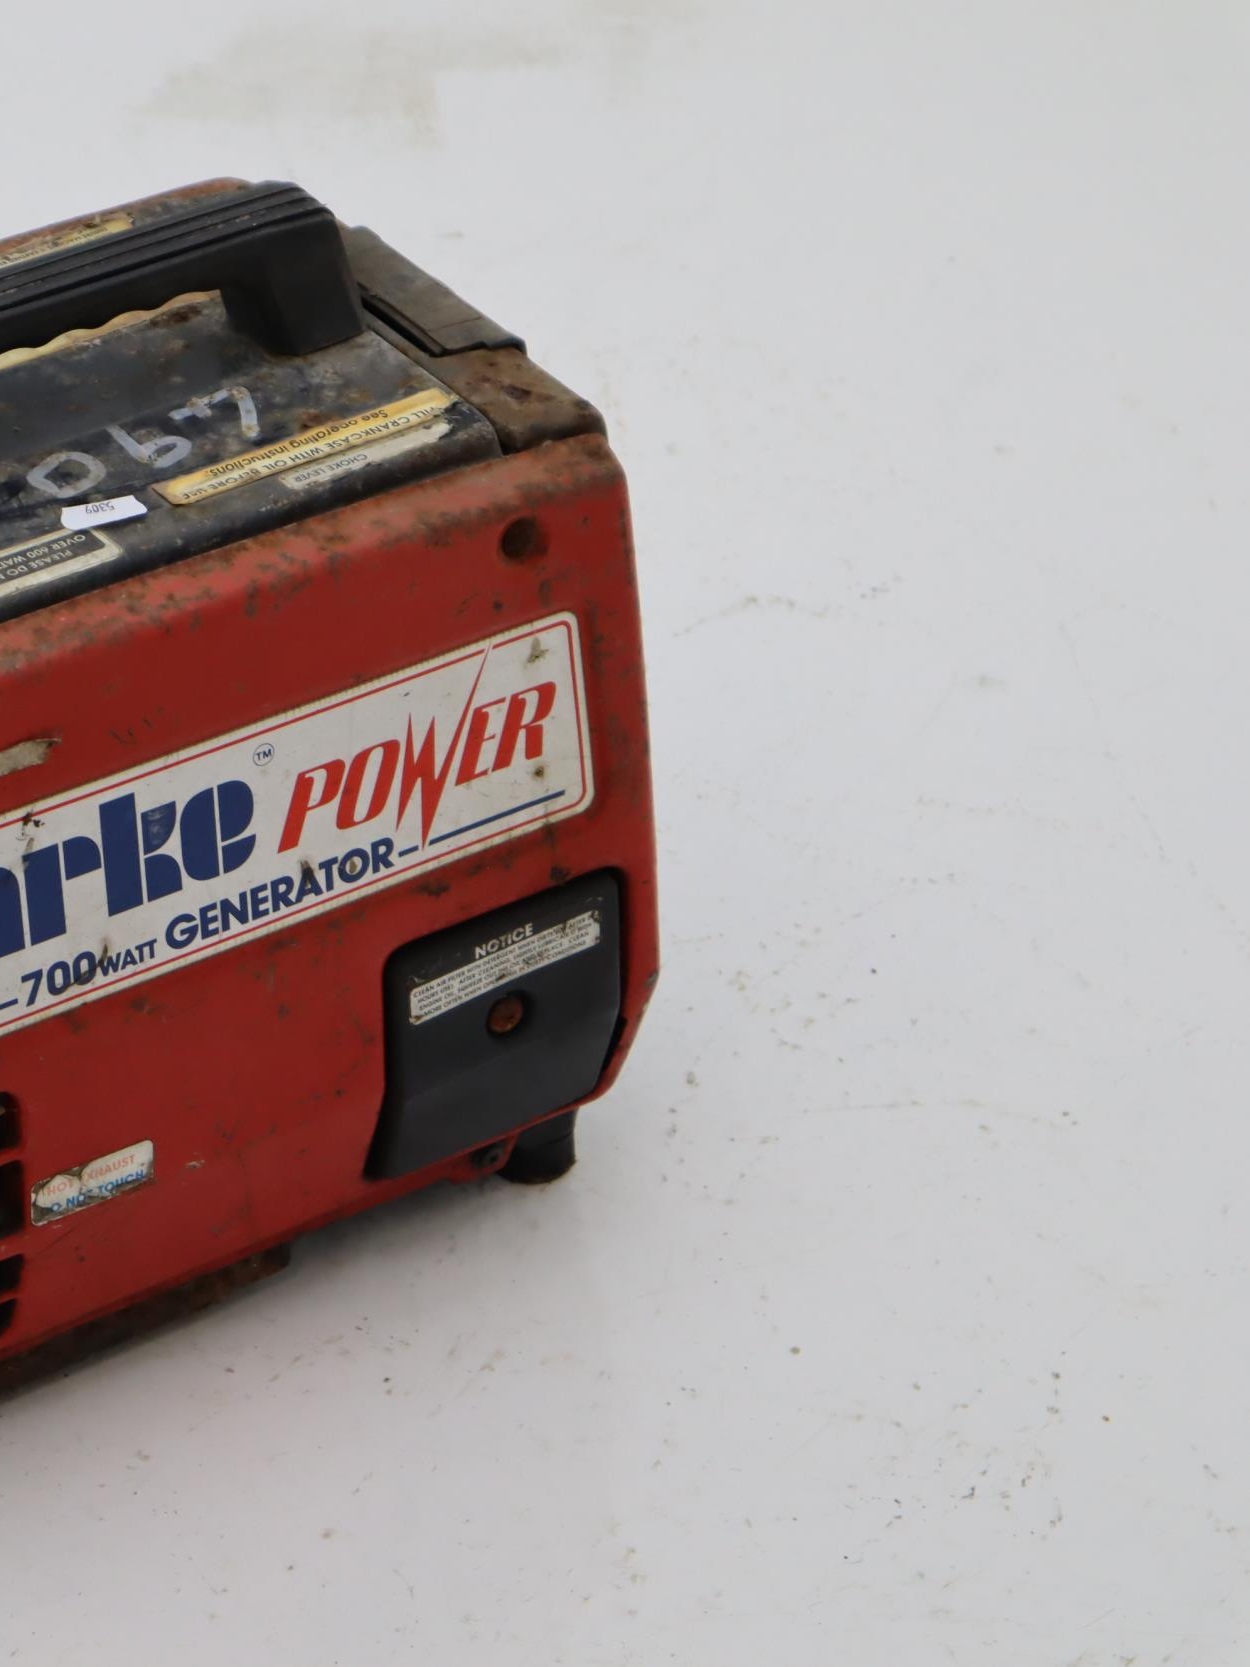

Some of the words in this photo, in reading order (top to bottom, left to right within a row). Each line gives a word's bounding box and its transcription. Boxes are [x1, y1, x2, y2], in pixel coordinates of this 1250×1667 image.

[359, 408, 389, 424] See
[323, 414, 411, 450] CRANKCASE
[287, 445, 325, 463] WITH
[325, 450, 369, 474] CHOKE
[260, 458, 289, 472] OIL
[292, 465, 326, 485] LEVER
[85, 501, 115, 514] 5309
[48, 532, 87, 550] OVER
[26, 548, 73, 568] PLEASE
[4, 564, 28, 576] DO
[277, 644, 556, 854] POWER
[165, 837, 395, 950] GENERATOR
[475, 923, 534, 960] NOTICE
[413, 983, 434, 998] CLEAN
